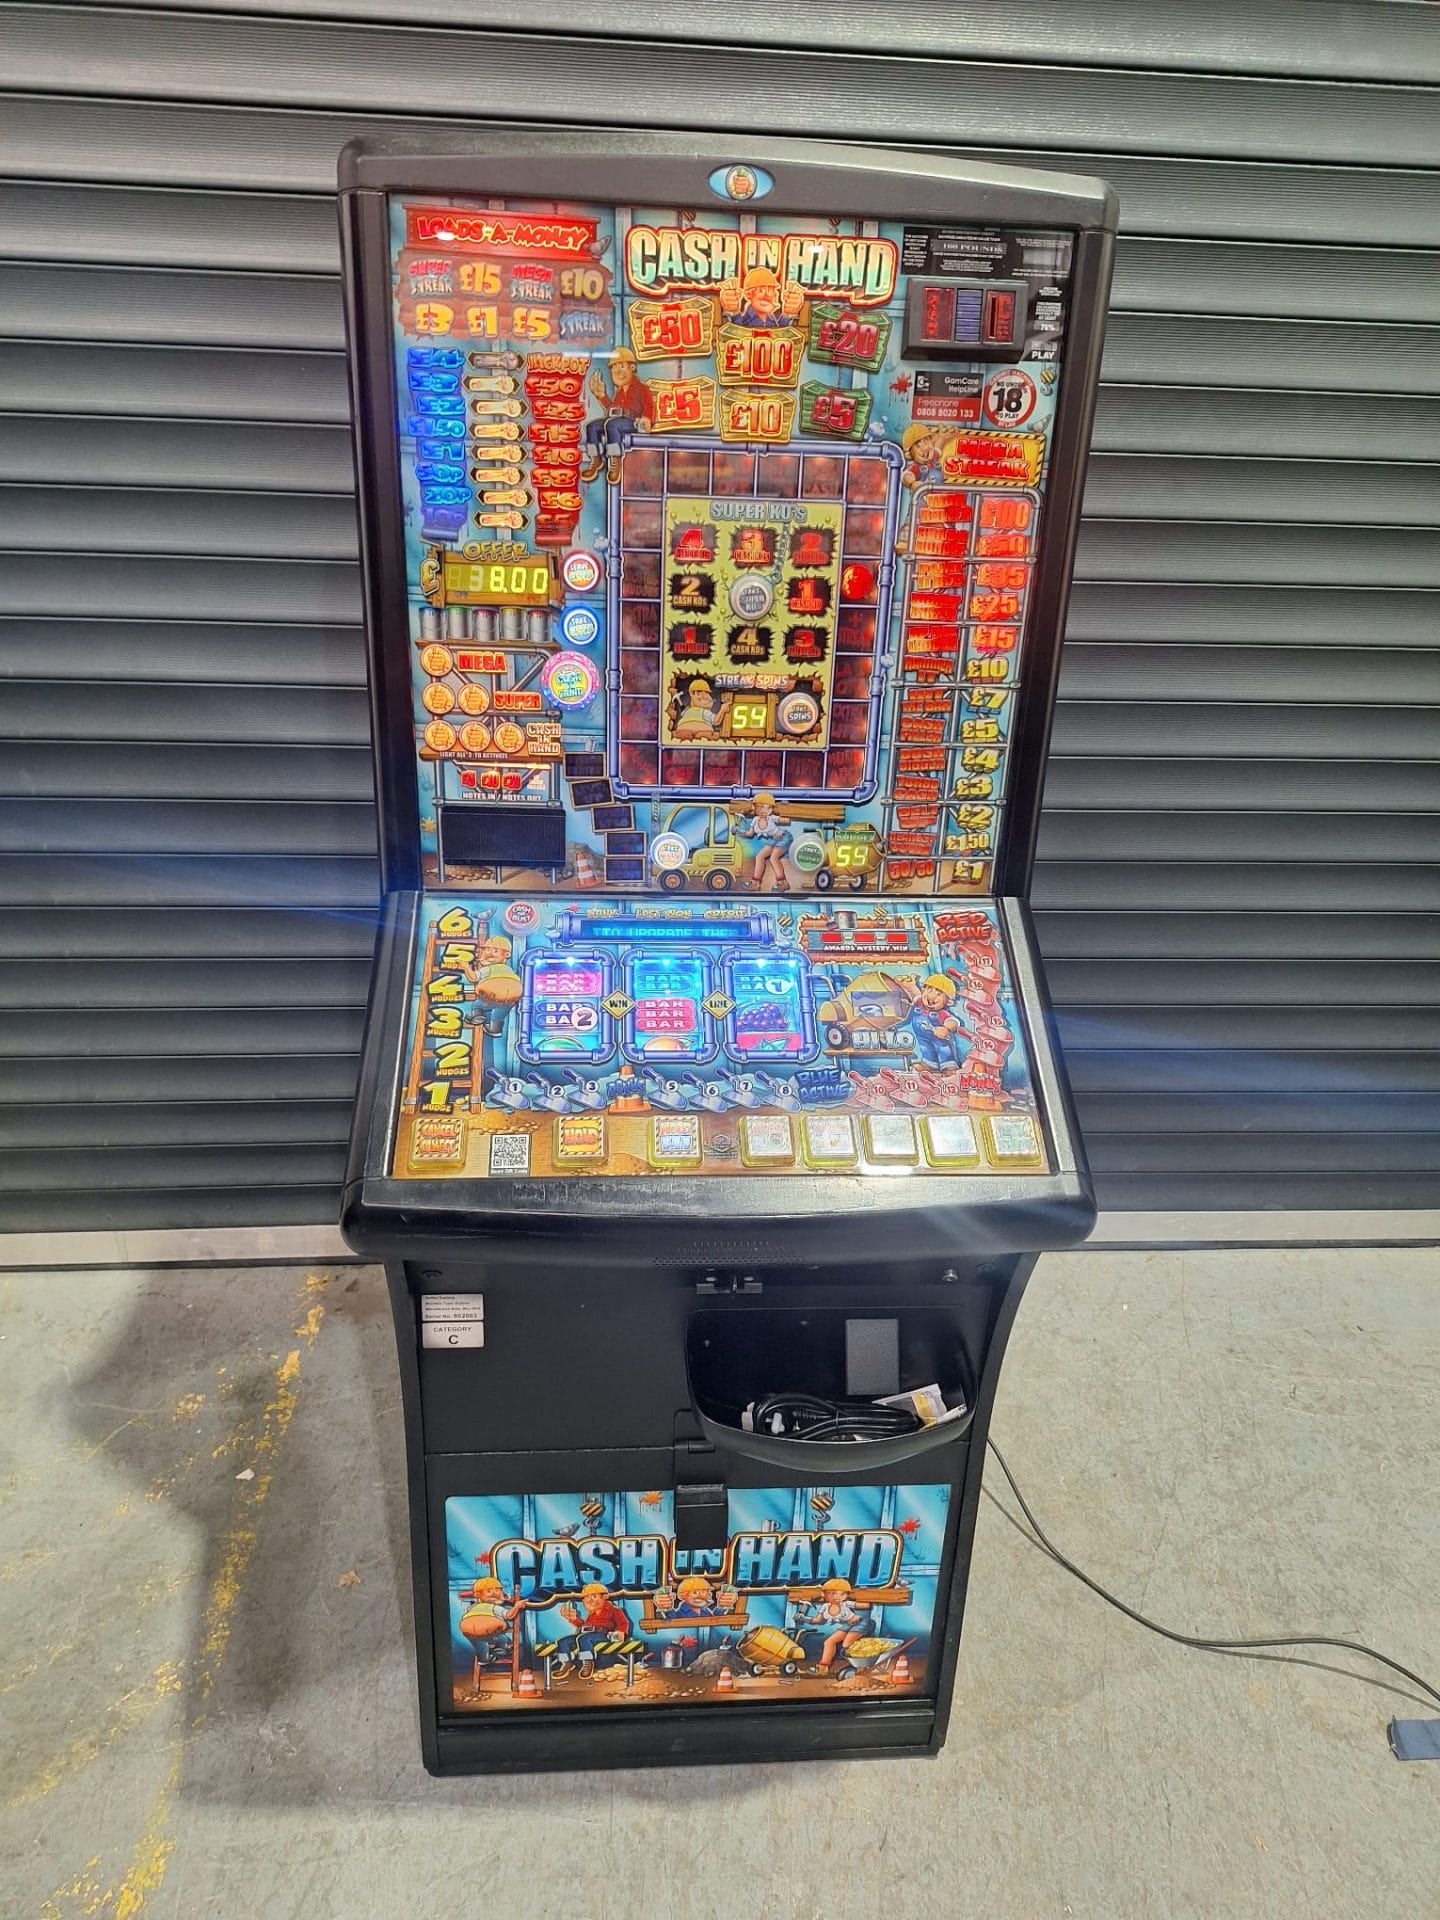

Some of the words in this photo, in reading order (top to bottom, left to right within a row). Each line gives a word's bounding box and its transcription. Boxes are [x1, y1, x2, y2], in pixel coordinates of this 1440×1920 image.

[628, 227, 740, 288] CASH
[746, 235, 781, 268] IN
[787, 237, 895, 297] HAND
[458, 261, 503, 297] £15
[510, 263, 554, 282] MEGA
[408, 276, 453, 296] STREAK
[509, 281, 554, 301] STREAK
[559, 267, 605, 302] £10
[414, 302, 455, 336] £3
[466, 304, 499, 338] £1
[512, 306, 552, 341] £5
[559, 308, 606, 339] STREAK
[642, 309, 706, 351] £50
[817, 319, 880, 360] £20
[526, 351, 591, 376] JACKPOT
[724, 336, 794, 379] £100
[1031, 350, 1055, 360] PLAY
[525, 376, 585, 397] £50
[944, 376, 980, 387] GamCare
[532, 400, 587, 422] £25
[657, 385, 702, 422] £5
[812, 393, 857, 433] £5
[729, 399, 784, 437] £10
[527, 422, 583, 444] £15
[532, 445, 583, 466] £10
[530, 468, 578, 488] £8
[539, 490, 584, 511] £6
[710, 502, 766, 522] SUPER
[680, 528, 704, 548] 4
[740, 530, 765, 551] 3
[800, 532, 822, 551] 2
[462, 540, 530, 562] OFFER
[680, 576, 701, 597] 2
[798, 579, 815, 600] 1
[673, 596, 693, 607] CASH
[682, 626, 697, 644] 1
[737, 628, 760, 646] 4
[793, 628, 816, 647] 3
[730, 645, 750, 656] CASH
[966, 656, 1009, 680] £10
[756, 674, 789, 690] SPINS
[494, 692, 542, 710] SUPER
[970, 687, 1009, 709] £7
[526, 723, 562, 736] CASH
[961, 718, 1000, 744] £5
[528, 743, 562, 755] HAND
[961, 747, 1000, 772] £4
[955, 774, 994, 798] £3
[462, 791, 486, 800] NOTES
[502, 793, 525, 802] NOTES
[957, 803, 995, 828] £2
[944, 832, 991, 851] £1.50
[953, 861, 985, 882] £1
[438, 906, 473, 934] 6
[512, 906, 531, 914] CASH
[934, 911, 987, 927] RED
[440, 930, 473, 939] NUDGES
[937, 925, 993, 942] ACTIVE
[443, 943, 477, 964] 5
[824, 944, 855, 952] AWARDS
[428, 975, 464, 996] 4
[431, 994, 464, 1003] NUDGES
[609, 999, 629, 1009] WIN
[645, 1000, 684, 1008] BAR
[709, 999, 729, 1009] LINE
[428, 1006, 463, 1030] 3
[577, 1010, 593, 1027] 2
[645, 1009, 684, 1018] BAR
[645, 1019, 684, 1028] BAR
[427, 1027, 460, 1037] NUDGES
[433, 1042, 471, 1069] 2
[436, 1067, 470, 1077] NUDGES
[798, 1069, 840, 1084] BLUE
[422, 1081, 451, 1106] 1
[553, 1086, 563, 1096] 2
[588, 1082, 597, 1092] 3
[606, 1080, 646, 1098] BONUS
[800, 1081, 850, 1099] ACTIVE
[873, 1085, 885, 1095] 10
[906, 1080, 917, 1091] 11
[422, 1104, 452, 1113] NUDGE
[563, 1127, 600, 1146] HOLD
[448, 1334, 459, 1345] C
[497, 1538, 660, 1599] CASH
[676, 1548, 723, 1575] IN
[737, 1532, 899, 1590] HAND
